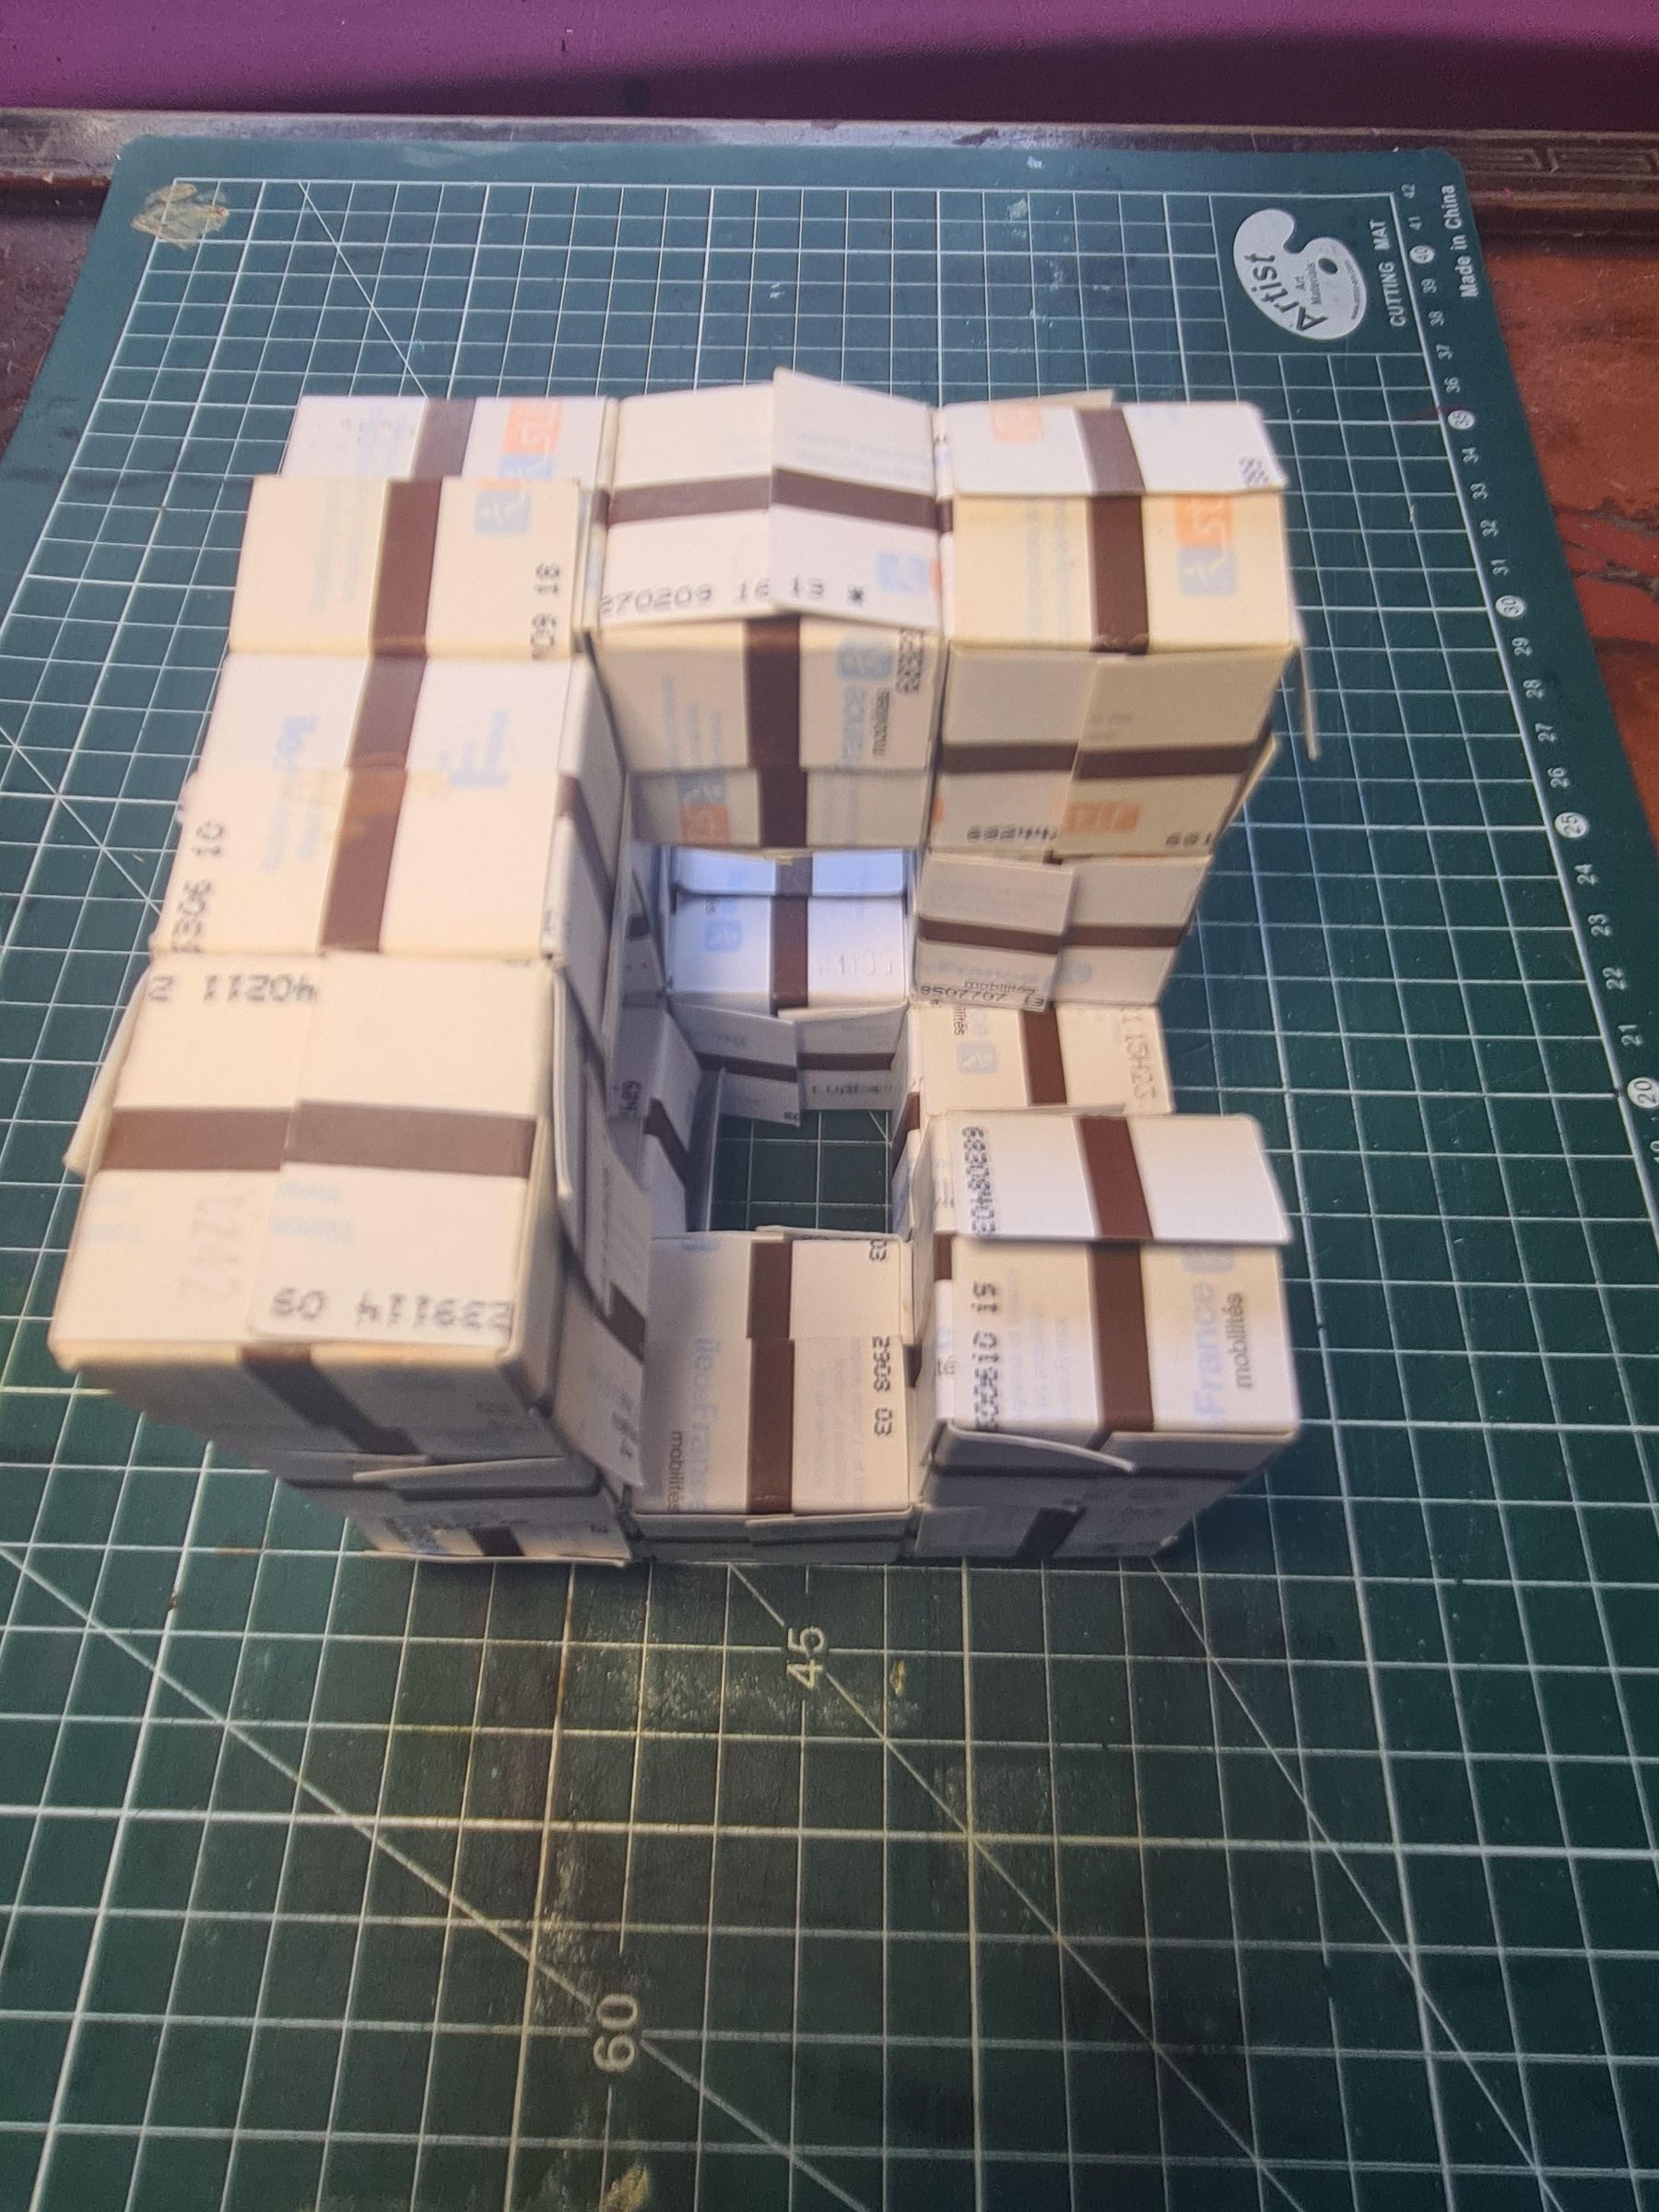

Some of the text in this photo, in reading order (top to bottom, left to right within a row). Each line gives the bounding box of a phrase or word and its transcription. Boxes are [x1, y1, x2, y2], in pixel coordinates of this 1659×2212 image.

[1441, 183, 1479, 299] Made in China
[1369, 218, 1407, 327] CUTTING MAT
[1242, 252, 1329, 332] Artist
[1294, 276, 1306, 292] Art
[1420, 278, 1437, 294] 39
[1436, 344, 1453, 360] 37
[1443, 376, 1461, 394] 36
[1469, 482, 1489, 500] 33
[1479, 519, 1500, 538] 32
[1489, 559, 1511, 577] 31
[1499, 595, 1520, 616] 30
[1512, 637, 1534, 657] 29
[1523, 678, 1545, 700] 28
[1535, 723, 1558, 744] 27
[1547, 767, 1570, 788] 26
[1574, 864, 1599, 887] 24
[1587, 913, 1613, 938] 23
[1602, 966, 1629, 991] 22
[1618, 1024, 1644, 1047] 21
[1633, 1079, 1658, 1104] 20
[785, 1625, 826, 1690] 45
[593, 1993, 640, 2074] 60
